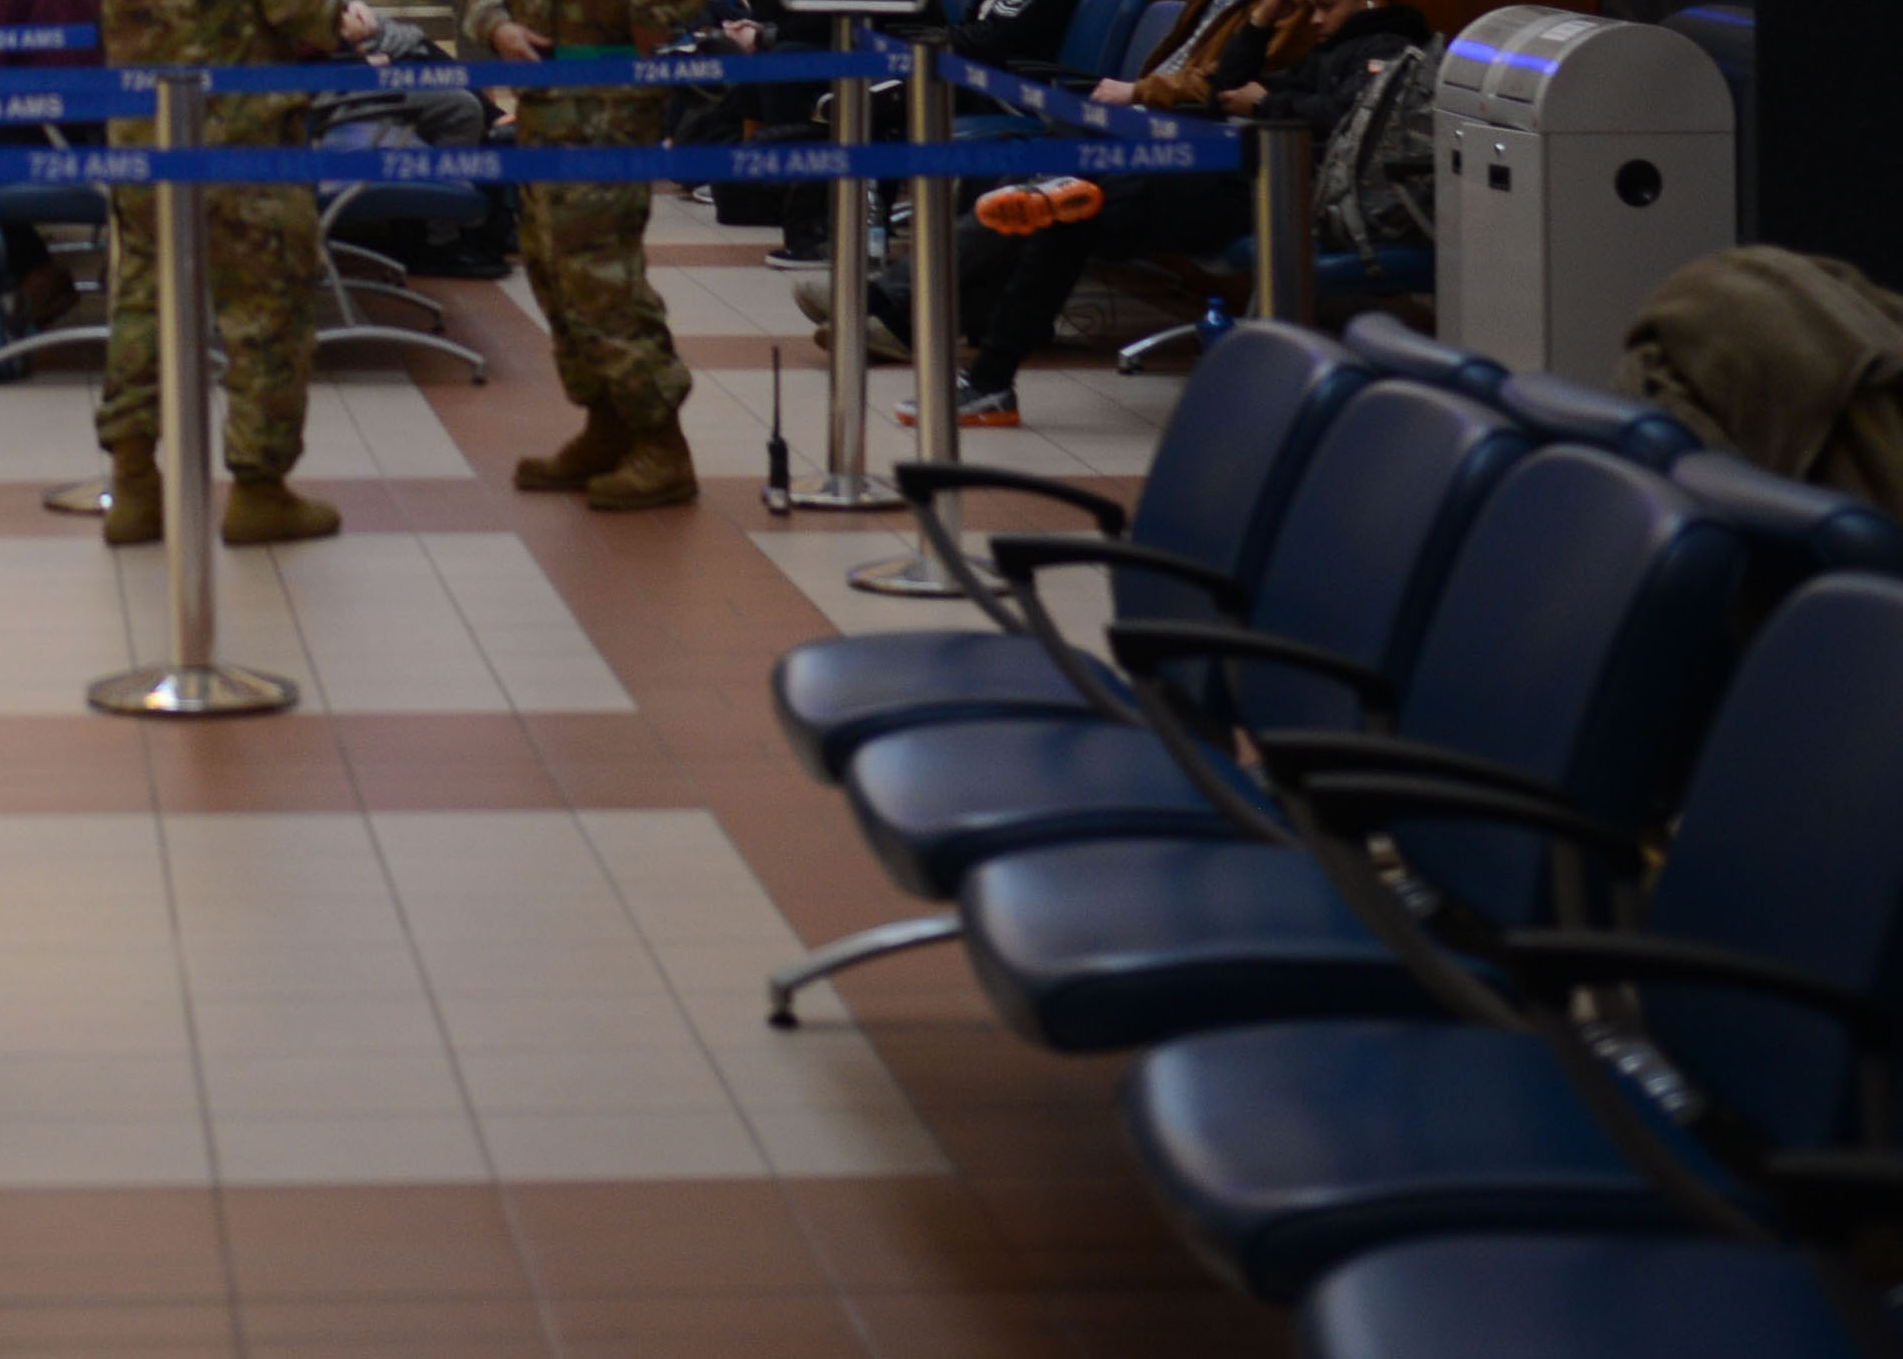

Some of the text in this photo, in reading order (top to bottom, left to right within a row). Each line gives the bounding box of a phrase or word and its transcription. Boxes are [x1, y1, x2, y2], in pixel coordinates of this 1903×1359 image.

[21, 29, 65, 50] AMS
[633, 60, 723, 82] 724 AMS
[887, 52, 912, 73] 72
[378, 67, 468, 87] 724 AMS
[7, 96, 63, 121] AMS
[30, 152, 150, 180] 724 AMS
[382, 151, 501, 179] 724 AMS
[732, 149, 849, 177] 724 AMS
[1078, 144, 1195, 171] 724 AMS
